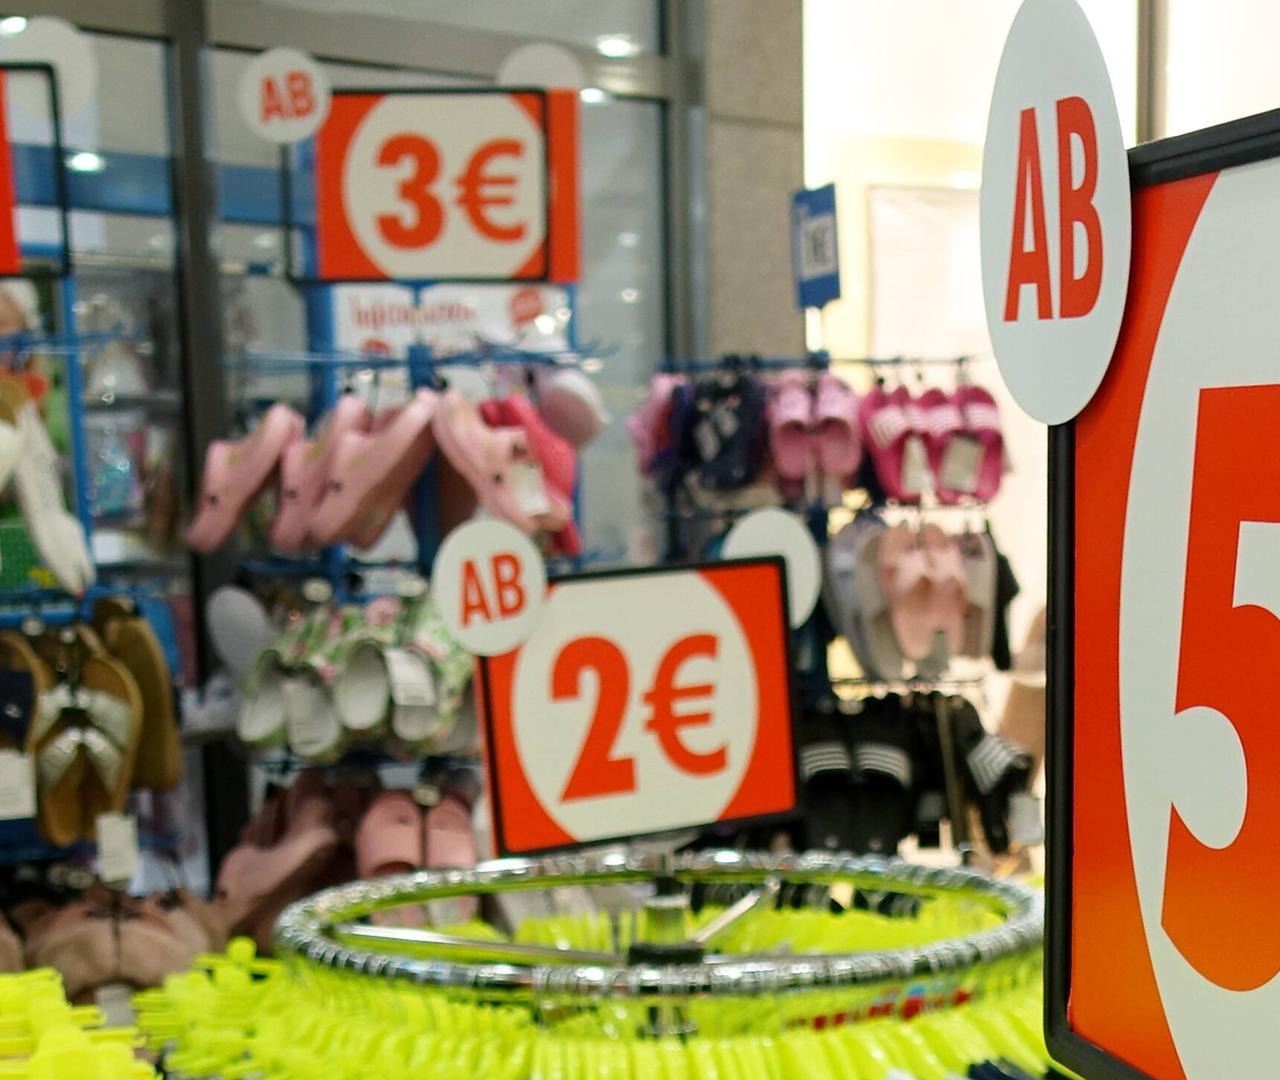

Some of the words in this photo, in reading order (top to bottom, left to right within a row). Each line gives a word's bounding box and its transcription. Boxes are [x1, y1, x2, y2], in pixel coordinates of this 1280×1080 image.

[261, 71, 315, 120] AB
[375, 133, 527, 251] 3€
[1003, 95, 1105, 323] AB
[460, 552, 526, 627] AB
[549, 633, 729, 802] 2€
